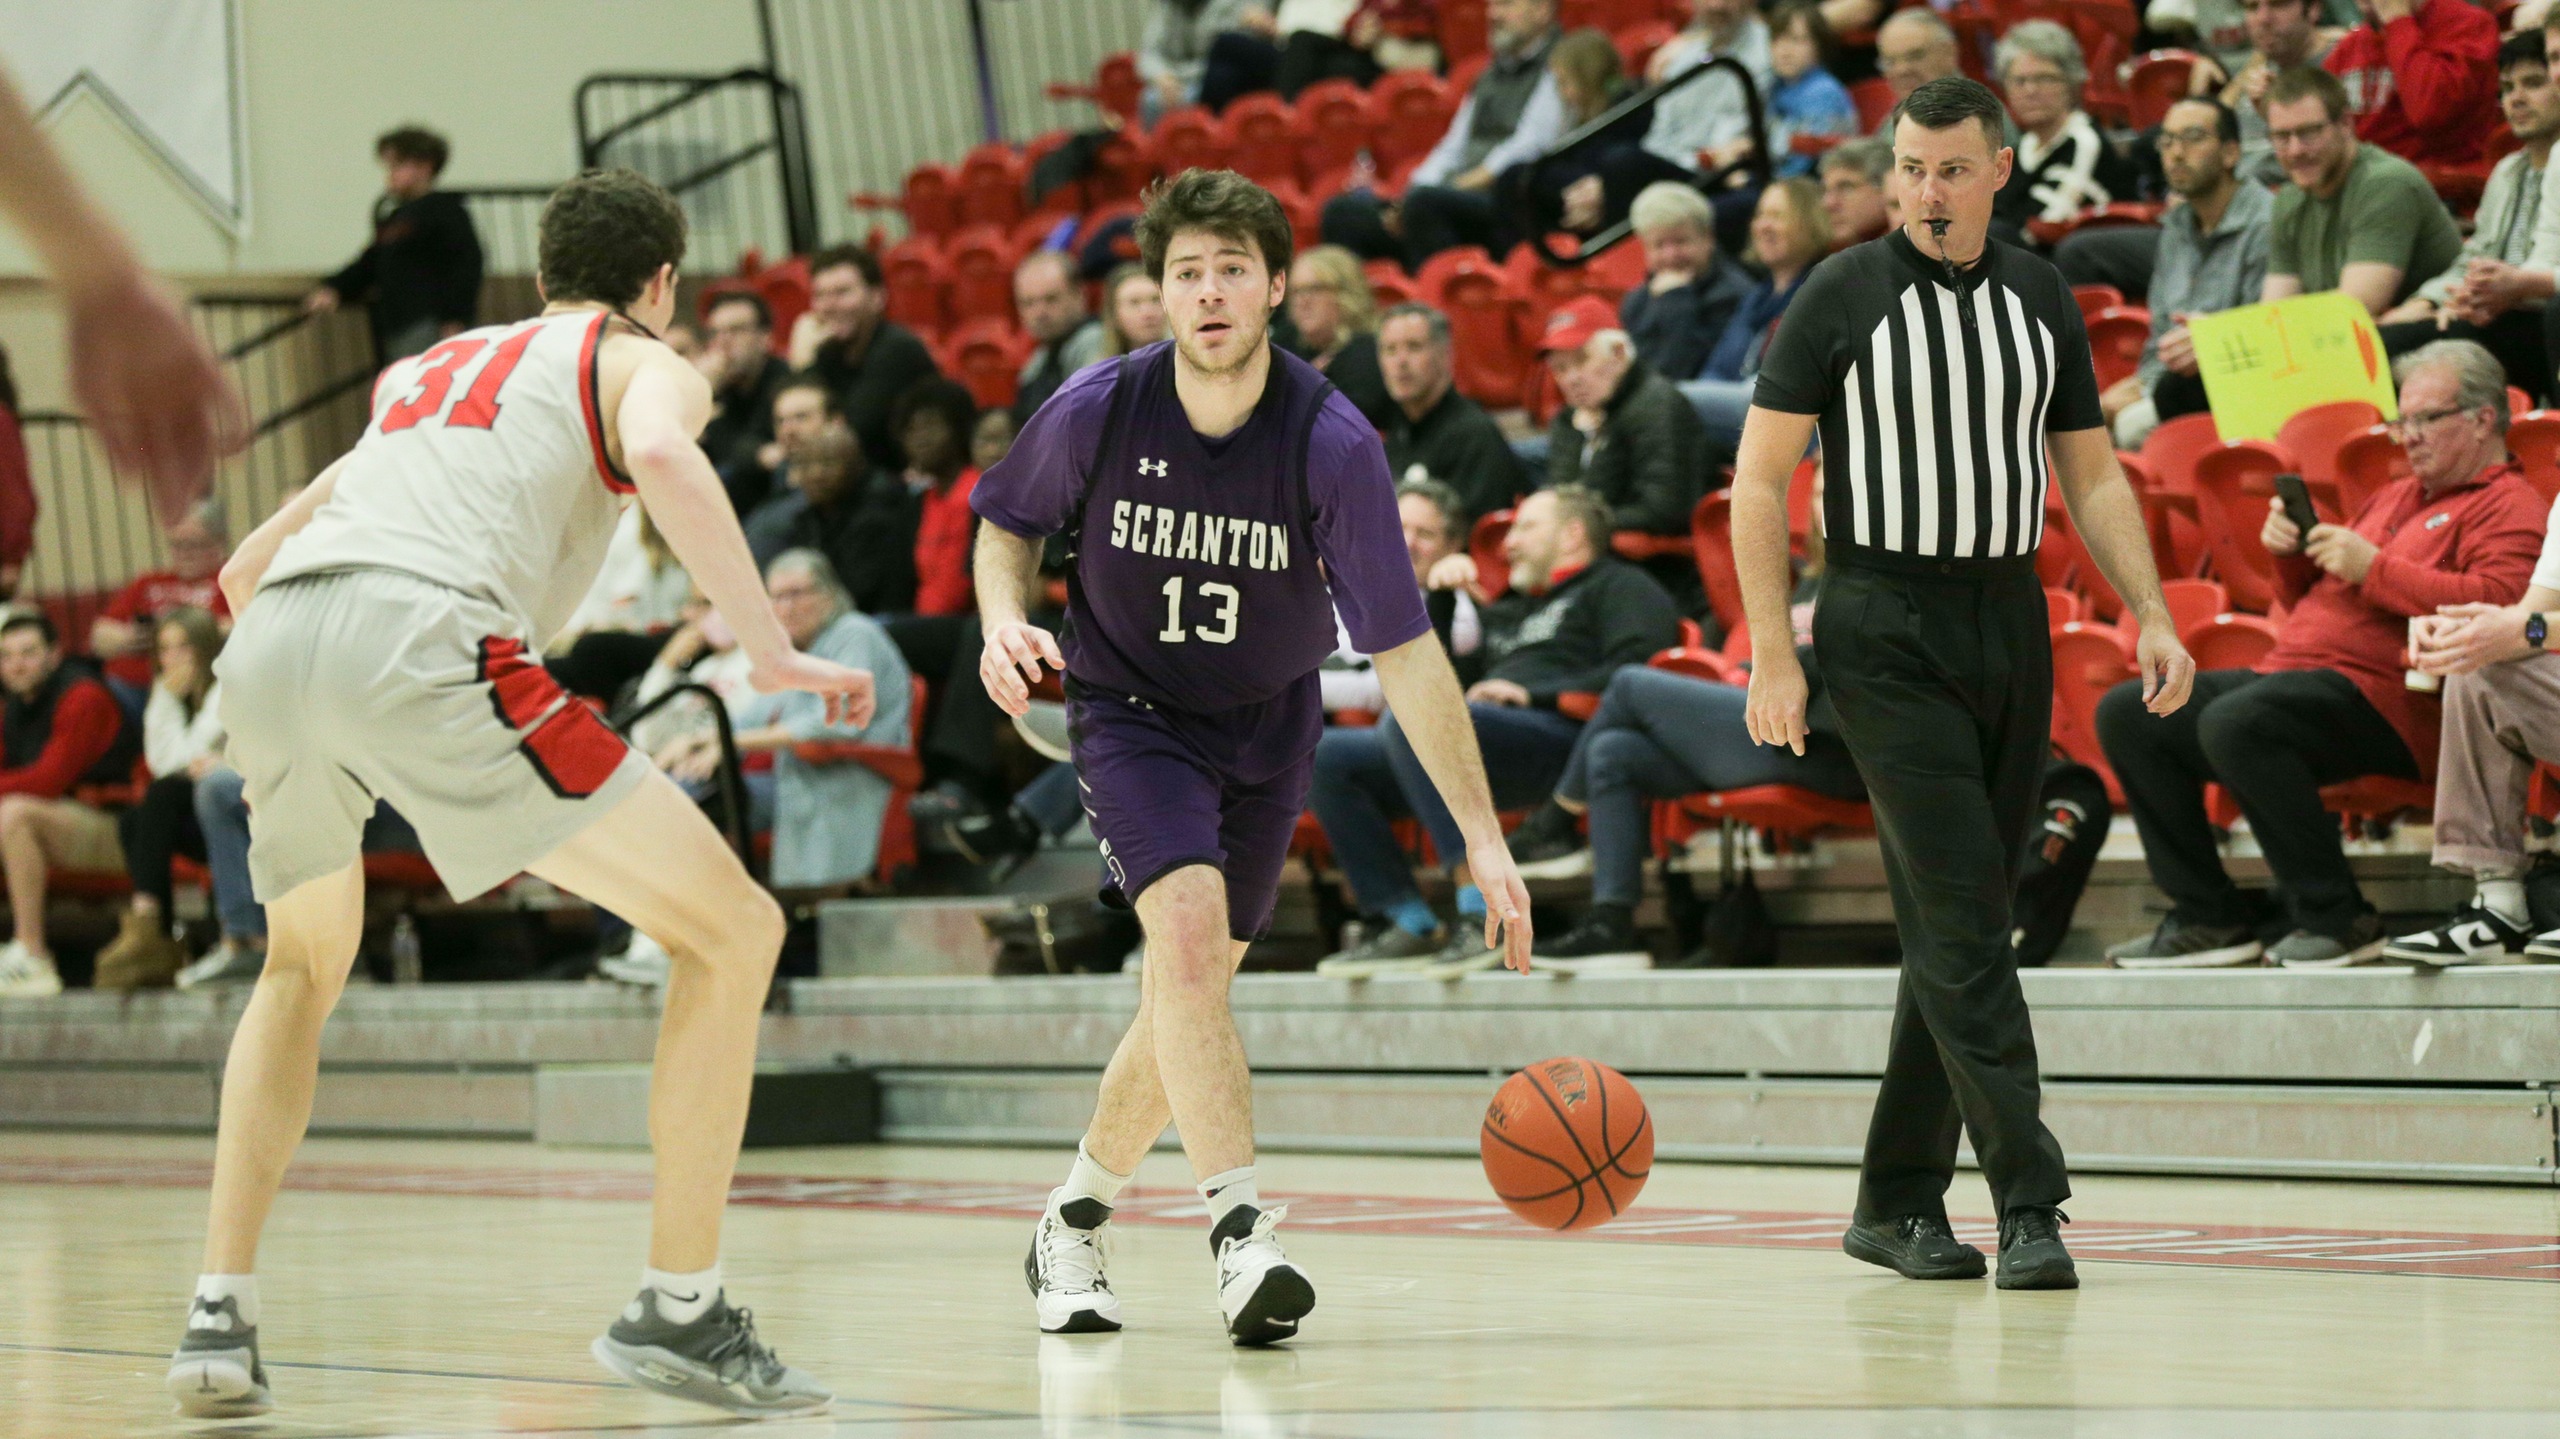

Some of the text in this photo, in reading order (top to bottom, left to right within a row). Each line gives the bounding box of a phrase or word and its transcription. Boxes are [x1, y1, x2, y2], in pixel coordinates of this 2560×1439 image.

[380, 324, 546, 435] 31
[1110, 499, 1289, 571] SCRANTON
[1158, 575, 1240, 644] 13
